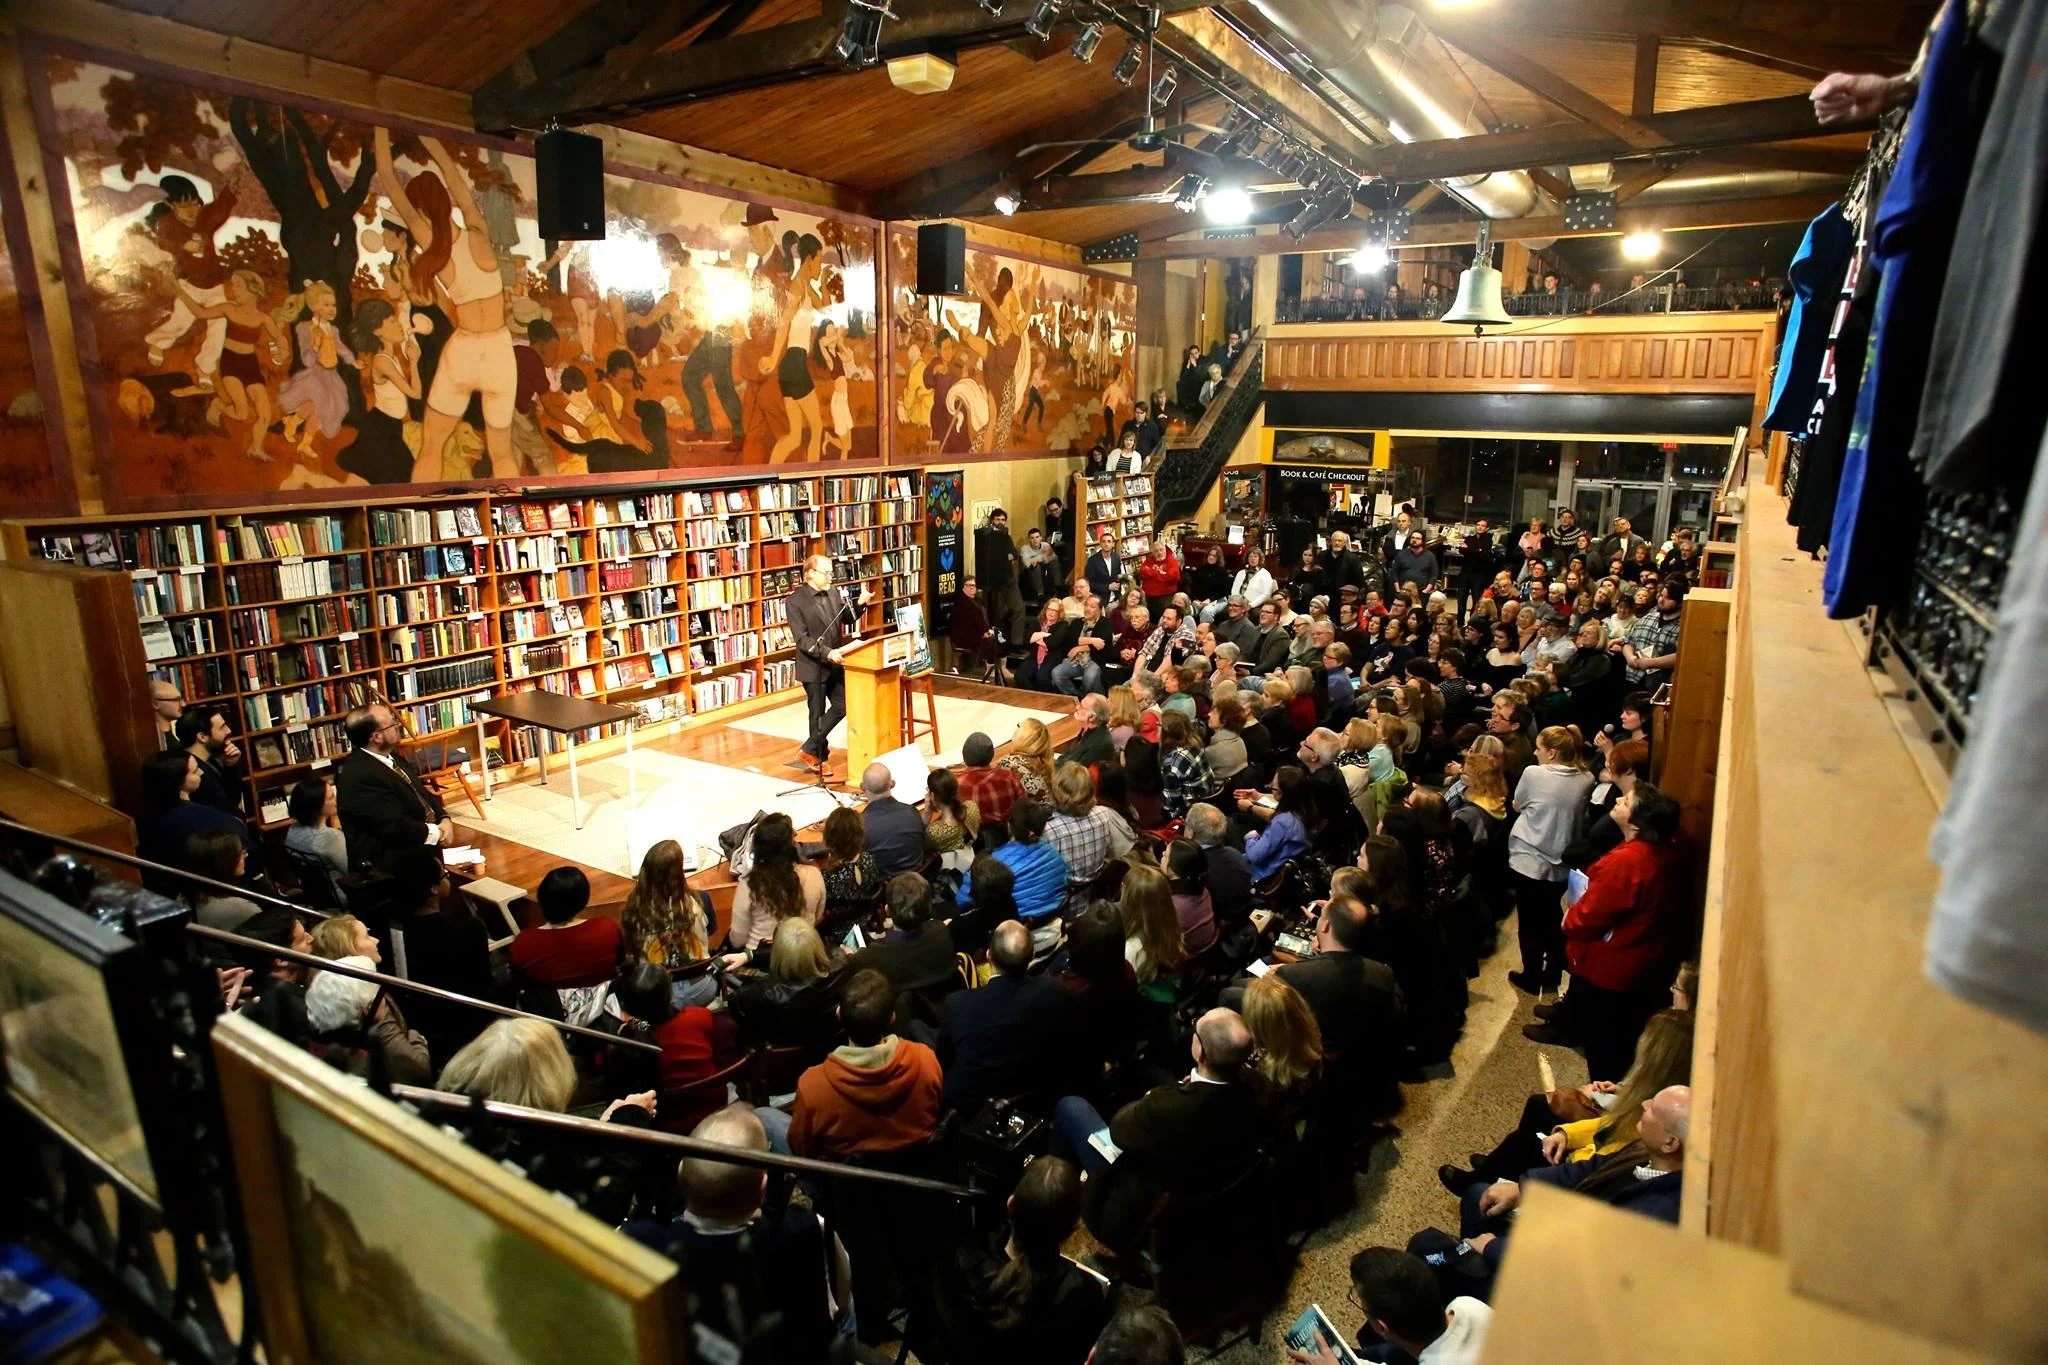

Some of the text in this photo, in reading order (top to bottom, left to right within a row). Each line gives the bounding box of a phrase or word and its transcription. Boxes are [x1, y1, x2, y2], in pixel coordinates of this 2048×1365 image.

[1280, 470, 1301, 478] BOOK
[1309, 470, 1327, 479] CAFÉ
[1328, 472, 1366, 481] CHECKOUT
[941, 572, 956, 582] BIG
[939, 581, 956, 595] READ
